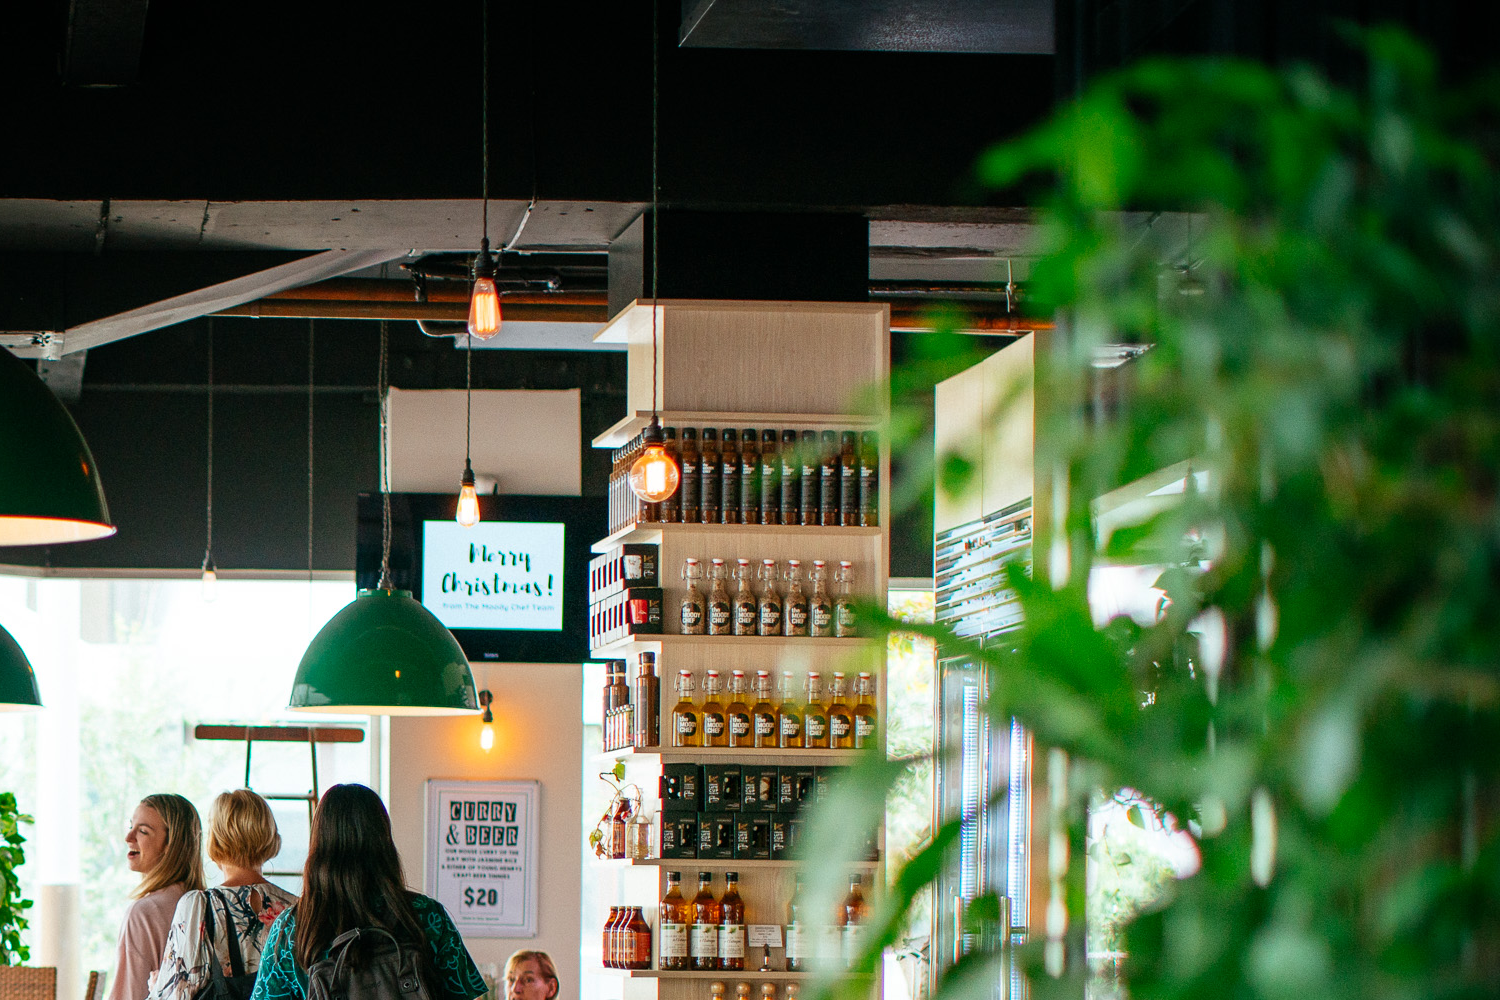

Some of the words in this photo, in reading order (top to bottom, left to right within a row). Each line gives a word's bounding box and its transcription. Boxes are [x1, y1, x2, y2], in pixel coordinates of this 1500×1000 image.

[469, 543, 530, 572] Merry
[442, 572, 553, 596] Christmas!
[450, 801, 517, 822] CURRY
[446, 824, 460, 845] &
[465, 825, 519, 846] BEER
[464, 886, 498, 908] $20
